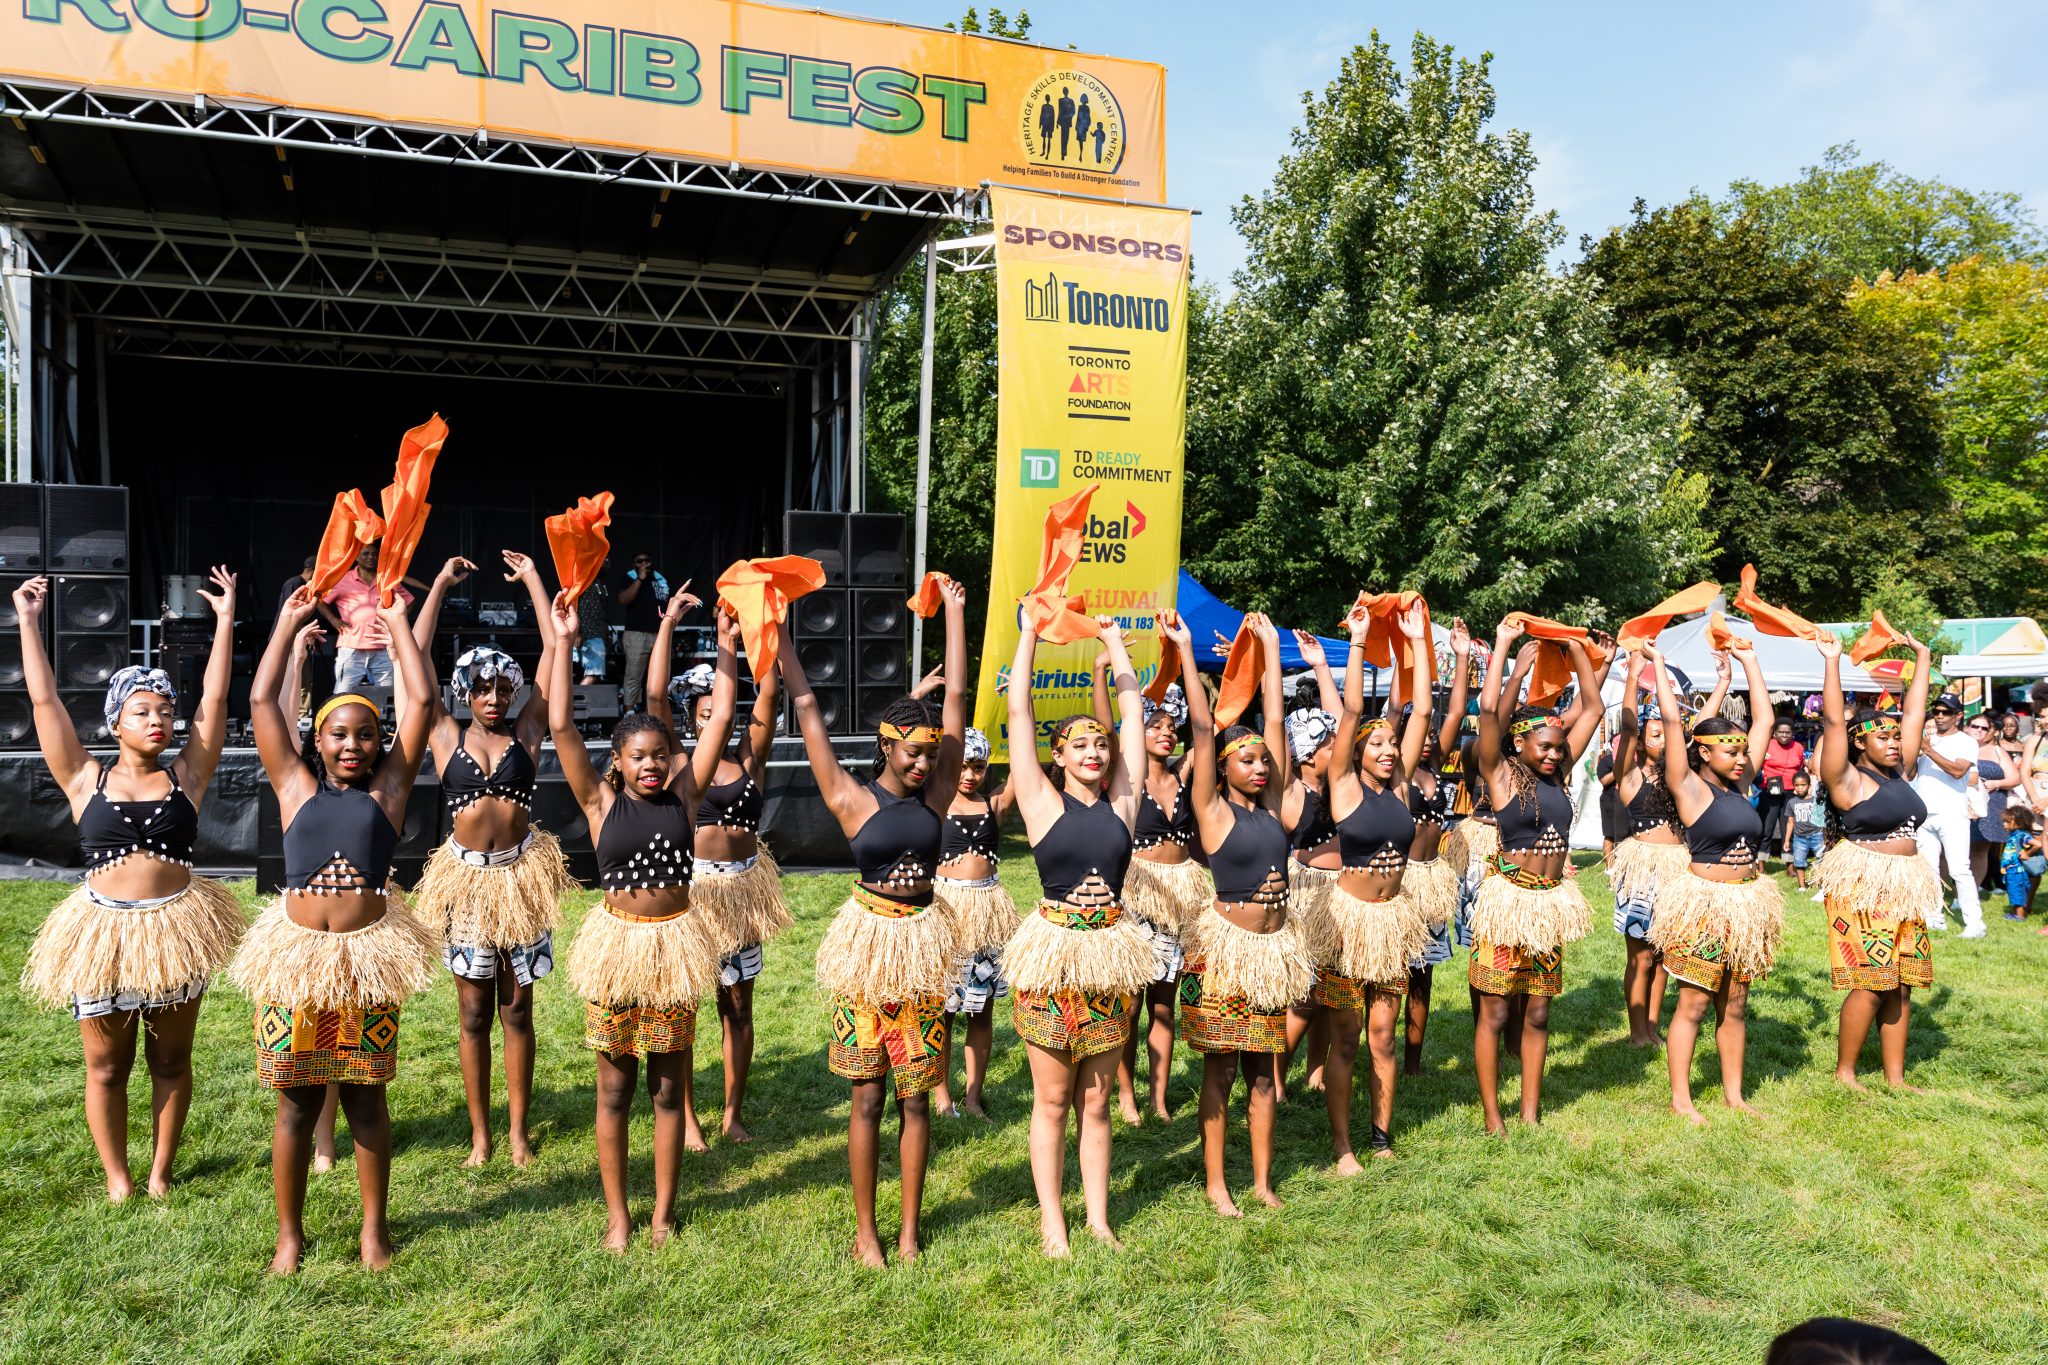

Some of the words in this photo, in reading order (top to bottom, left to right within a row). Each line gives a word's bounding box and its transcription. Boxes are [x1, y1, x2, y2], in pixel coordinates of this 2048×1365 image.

[720, 44, 987, 143] FEST
[1022, 102, 1036, 155] HERITAGE
[1030, 74, 1057, 100] SKILLS
[1058, 72, 1116, 119] DEVELOPMENT
[1103, 122, 1118, 165] CENTRE
[1002, 164, 1026, 176] Helping
[1026, 167, 1052, 178] Families
[1053, 170, 1060, 178] To
[1060, 171, 1076, 180] Build
[1081, 173, 1107, 185] Stronger
[1107, 176, 1140, 187] Foundation
[1004, 224, 1183, 263] SPONSORS
[1068, 356, 1131, 371] TORONTO
[1068, 372, 1131, 396] ARTS
[1068, 398, 1131, 411] FOUNDATION
[1024, 455, 1056, 481] TD
[1074, 450, 1093, 464] TD
[1096, 451, 1142, 466] READY
[1073, 466, 1172, 484] COMMITMENT
[1081, 514, 1129, 539] bal
[1079, 543, 1127, 563] EWS
[1112, 616, 1132, 629] CAL
[1135, 616, 1154, 630] 183
[1032, 692, 1083, 700] SATELLITE
